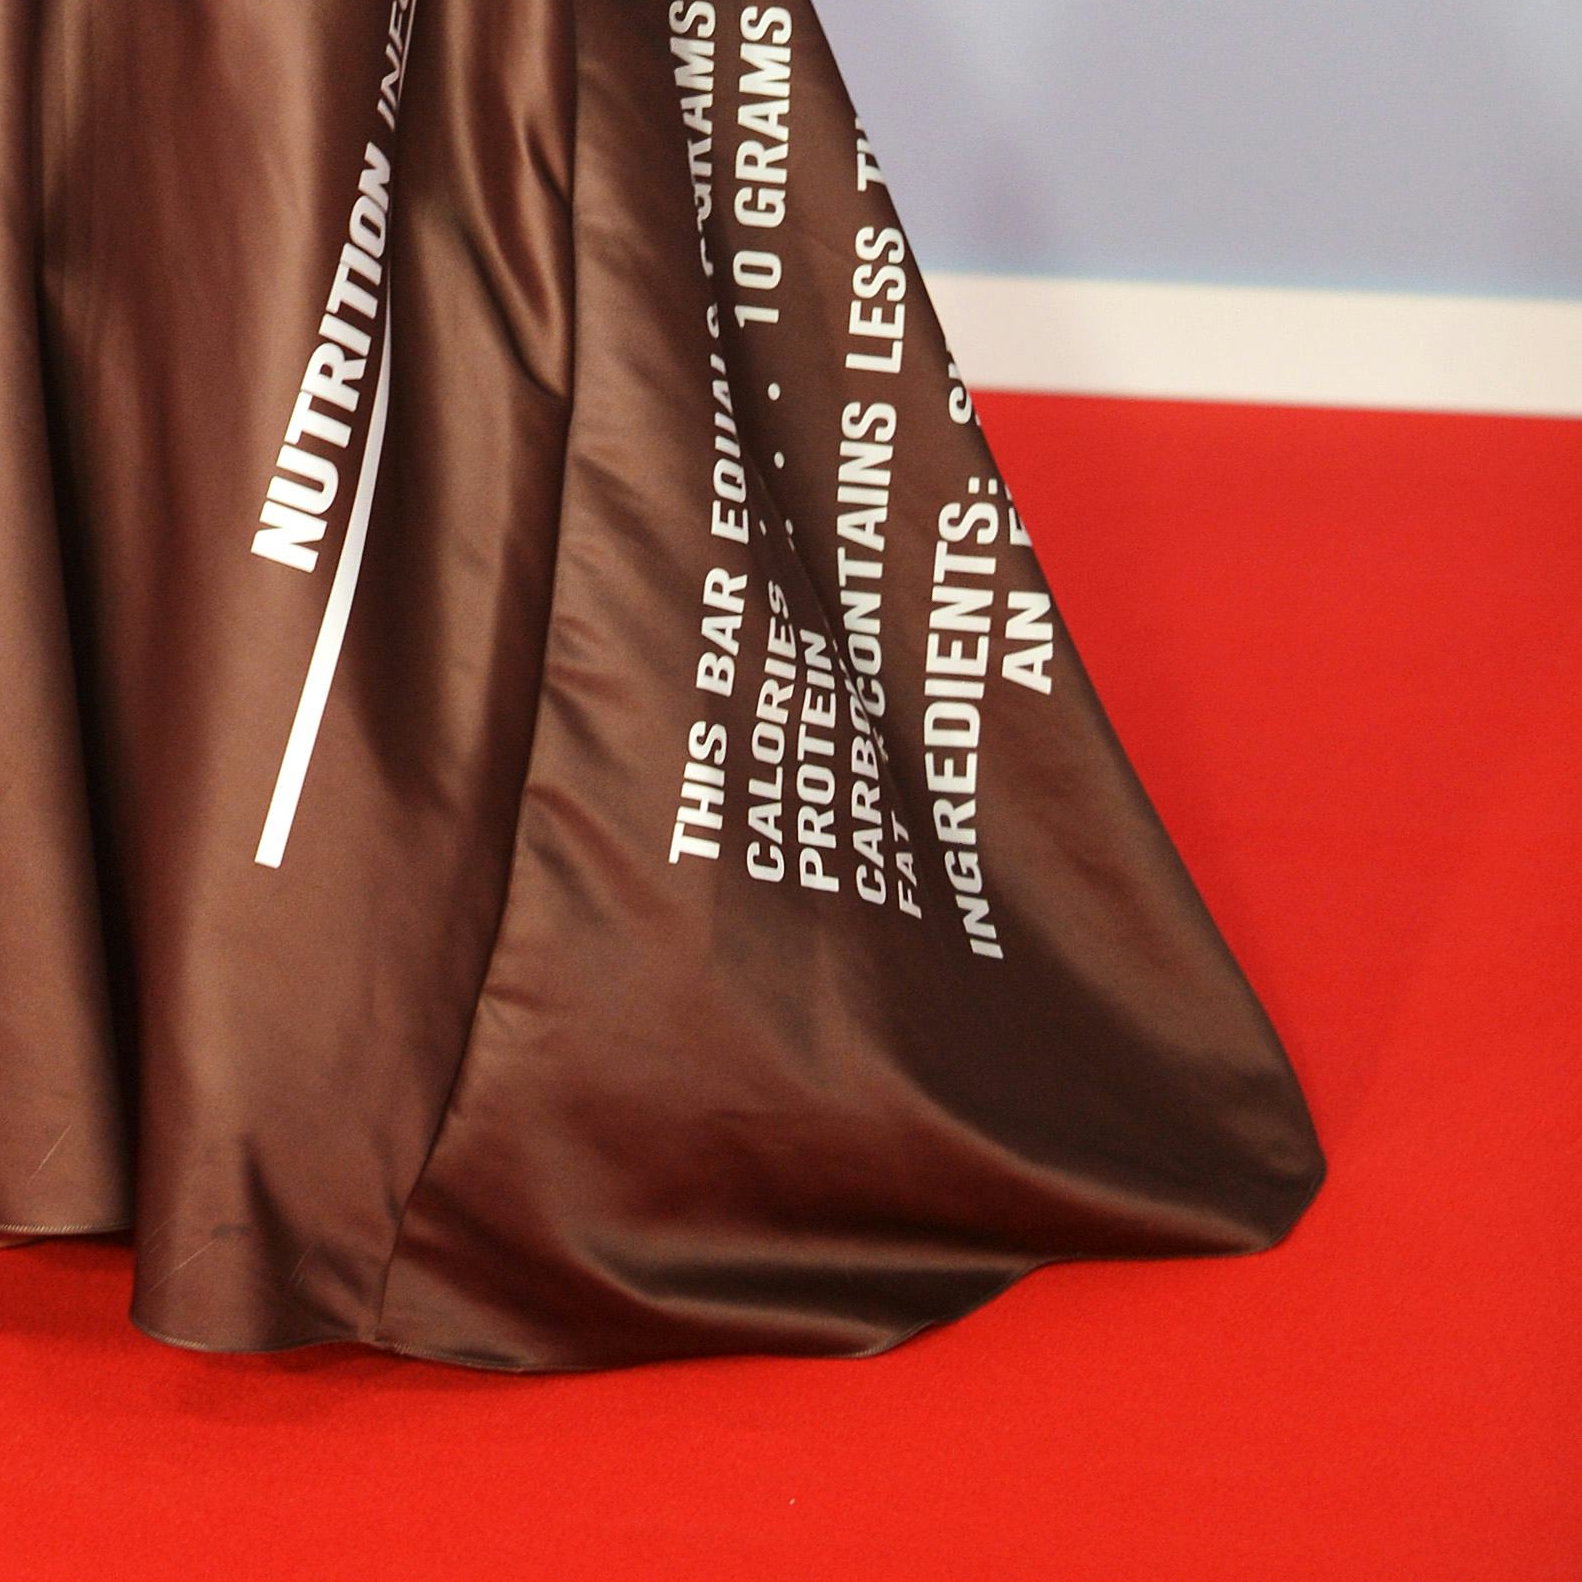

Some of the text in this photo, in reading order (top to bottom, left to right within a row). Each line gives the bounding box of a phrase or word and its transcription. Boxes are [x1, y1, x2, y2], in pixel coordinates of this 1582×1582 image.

[733, 5, 793, 328] 10 GRAMS
[249, 140, 393, 573] NUTRITION
[845, 226, 907, 374] LESS
[695, 567, 748, 697] BAR
[837, 400, 897, 719] CONTAINS
[1002, 590, 1054, 696] AN
[668, 720, 728, 864] THIS
[745, 579, 798, 884] CALORIES
[795, 628, 840, 893] PROTEIN
